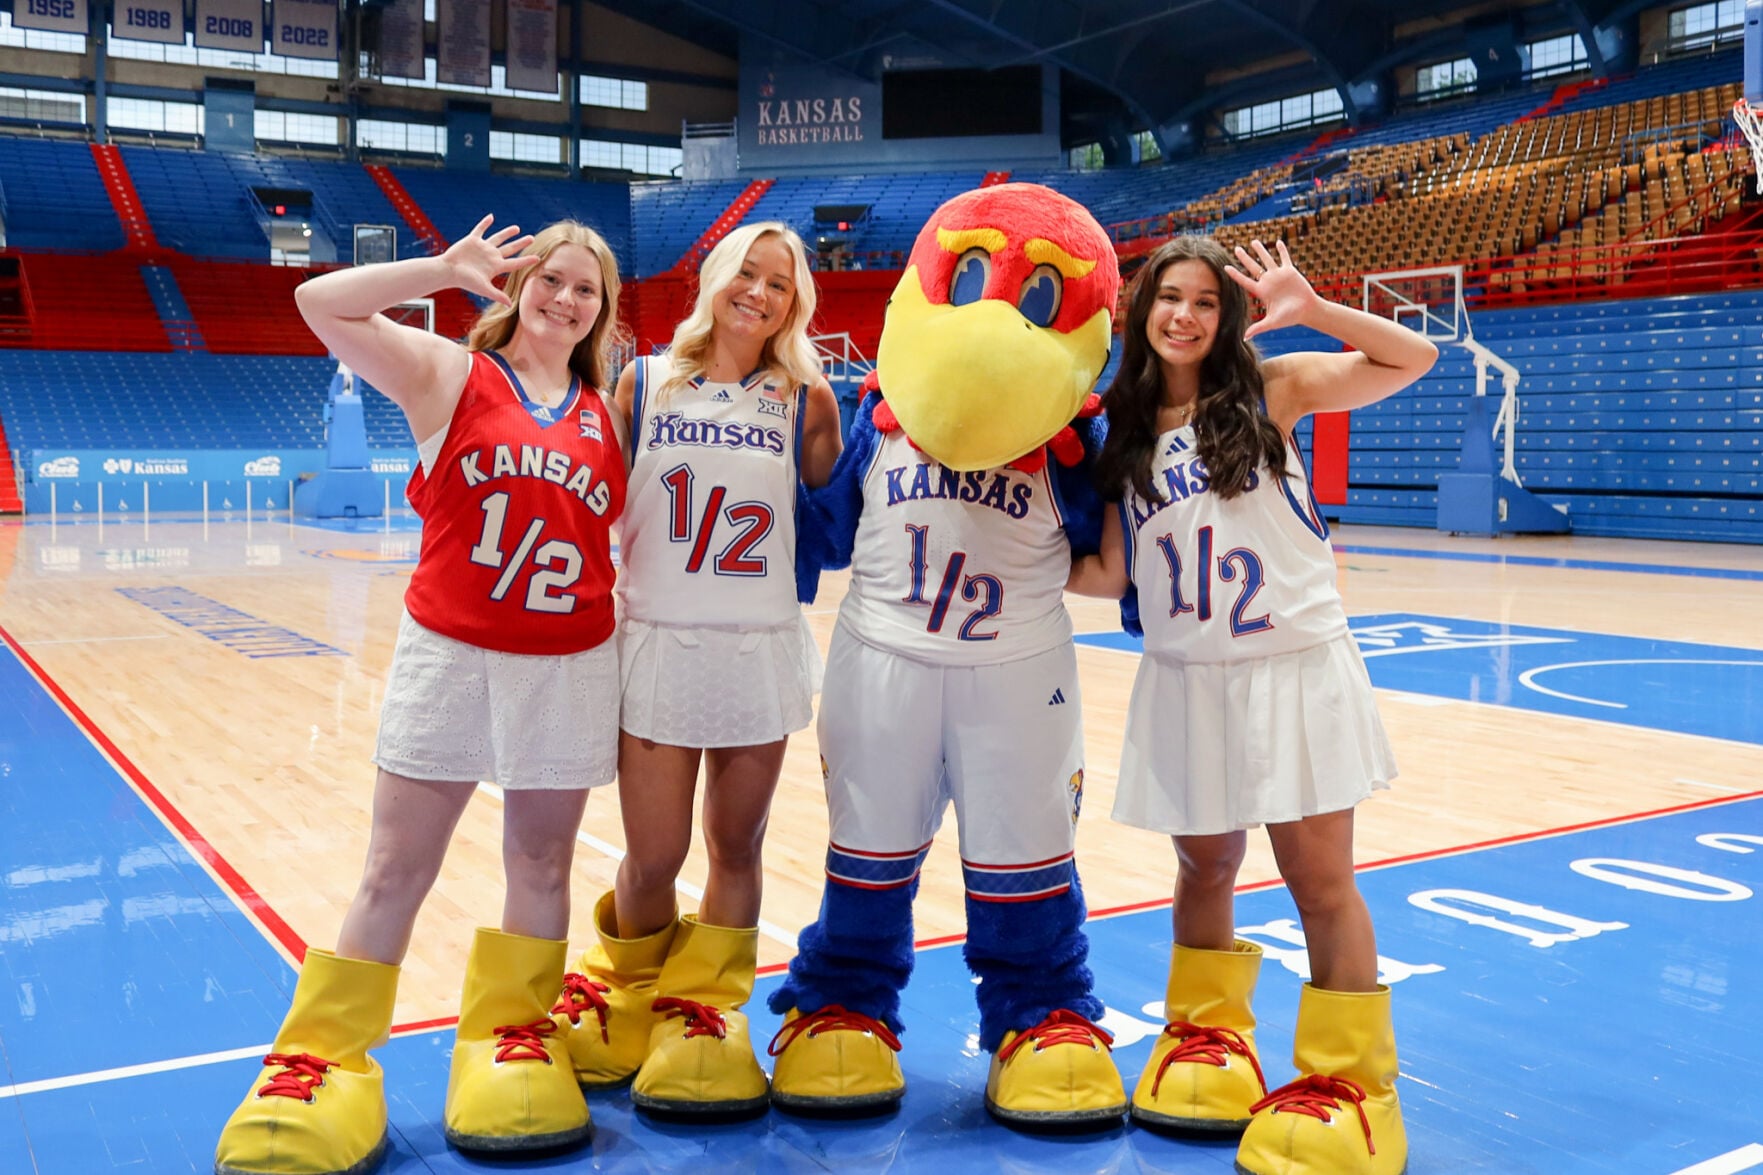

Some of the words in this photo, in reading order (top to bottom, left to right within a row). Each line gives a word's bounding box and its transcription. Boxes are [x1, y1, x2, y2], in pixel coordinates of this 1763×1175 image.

[27, 0, 75, 19] 1952
[127, 7, 171, 29] 1988
[205, 16, 253, 38] 2008
[281, 24, 329, 47] 2022
[226, 113, 234, 128] 1
[758, 97, 862, 126] KANSAS
[464, 133, 474, 147] 2
[758, 125, 864, 145] BASKETBALL
[647, 411, 786, 456] Kansas
[134, 462, 188, 475] Kansas
[371, 461, 410, 473] ansas
[460, 444, 611, 517] KANSAS
[885, 463, 1033, 519] KANSAS
[660, 463, 774, 577] 1/2
[469, 491, 584, 615] 1/2
[902, 523, 1004, 641] 1/2
[1156, 525, 1275, 638] 1/2
